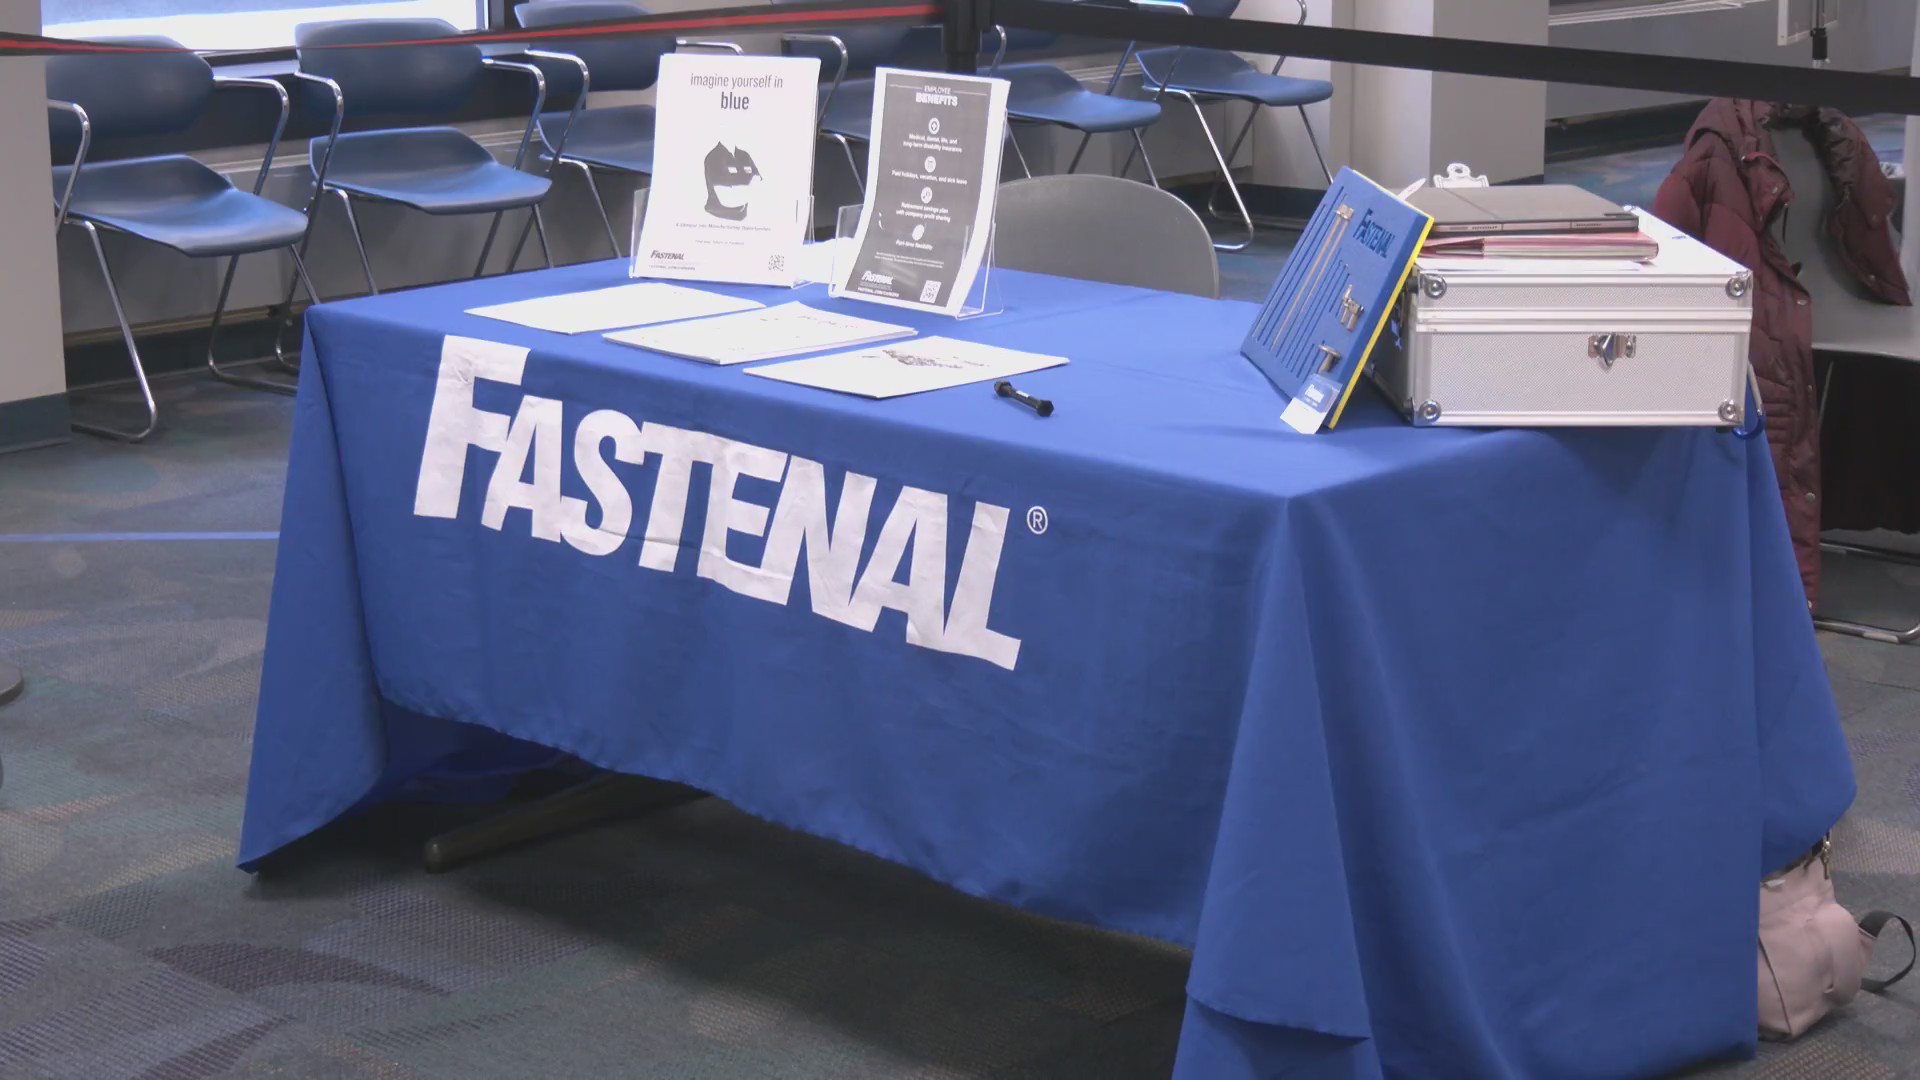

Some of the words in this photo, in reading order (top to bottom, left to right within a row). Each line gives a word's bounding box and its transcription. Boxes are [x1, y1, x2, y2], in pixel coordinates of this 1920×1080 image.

[690, 73, 729, 89] imagine
[731, 74, 773, 90] yourself
[774, 75, 784, 88] in
[924, 85, 951, 95] EMPLOYEE
[720, 92, 750, 110] blue
[915, 92, 958, 107] BENEFITS
[1353, 208, 1396, 258] FASTENAL
[650, 249, 685, 261] FASTENAL
[413, 334, 1022, 672] FASTENAL
